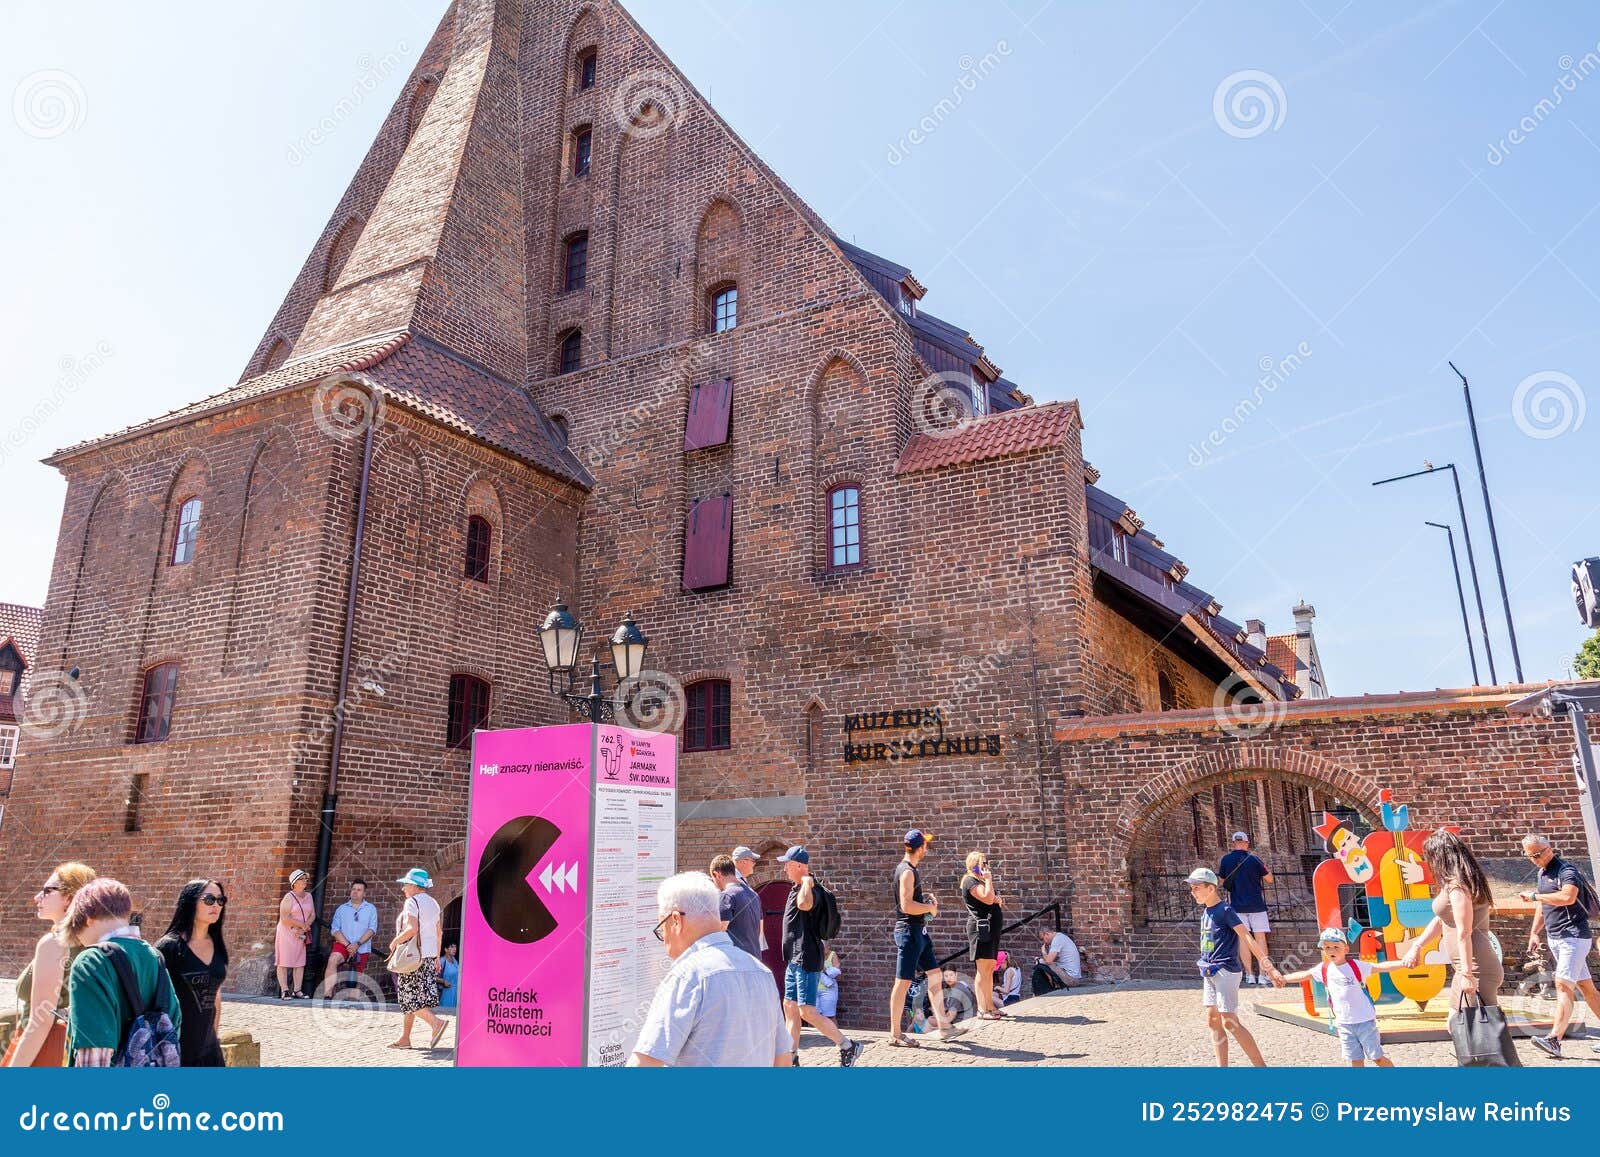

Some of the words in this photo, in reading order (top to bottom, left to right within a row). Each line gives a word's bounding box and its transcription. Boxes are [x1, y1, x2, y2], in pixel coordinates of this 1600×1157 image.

[844, 708, 942, 732] MUZEUM
[844, 736, 979, 763] BURSZTYNU
[479, 764, 499, 776] Hejt
[500, 763, 532, 775] znaczy
[629, 762, 657, 771] JARMARK
[641, 775, 671, 785] DOMINIKA
[488, 987, 538, 1003] Gdańsk
[488, 1003, 543, 1020] Miastem
[487, 1019, 552, 1037] Równości
